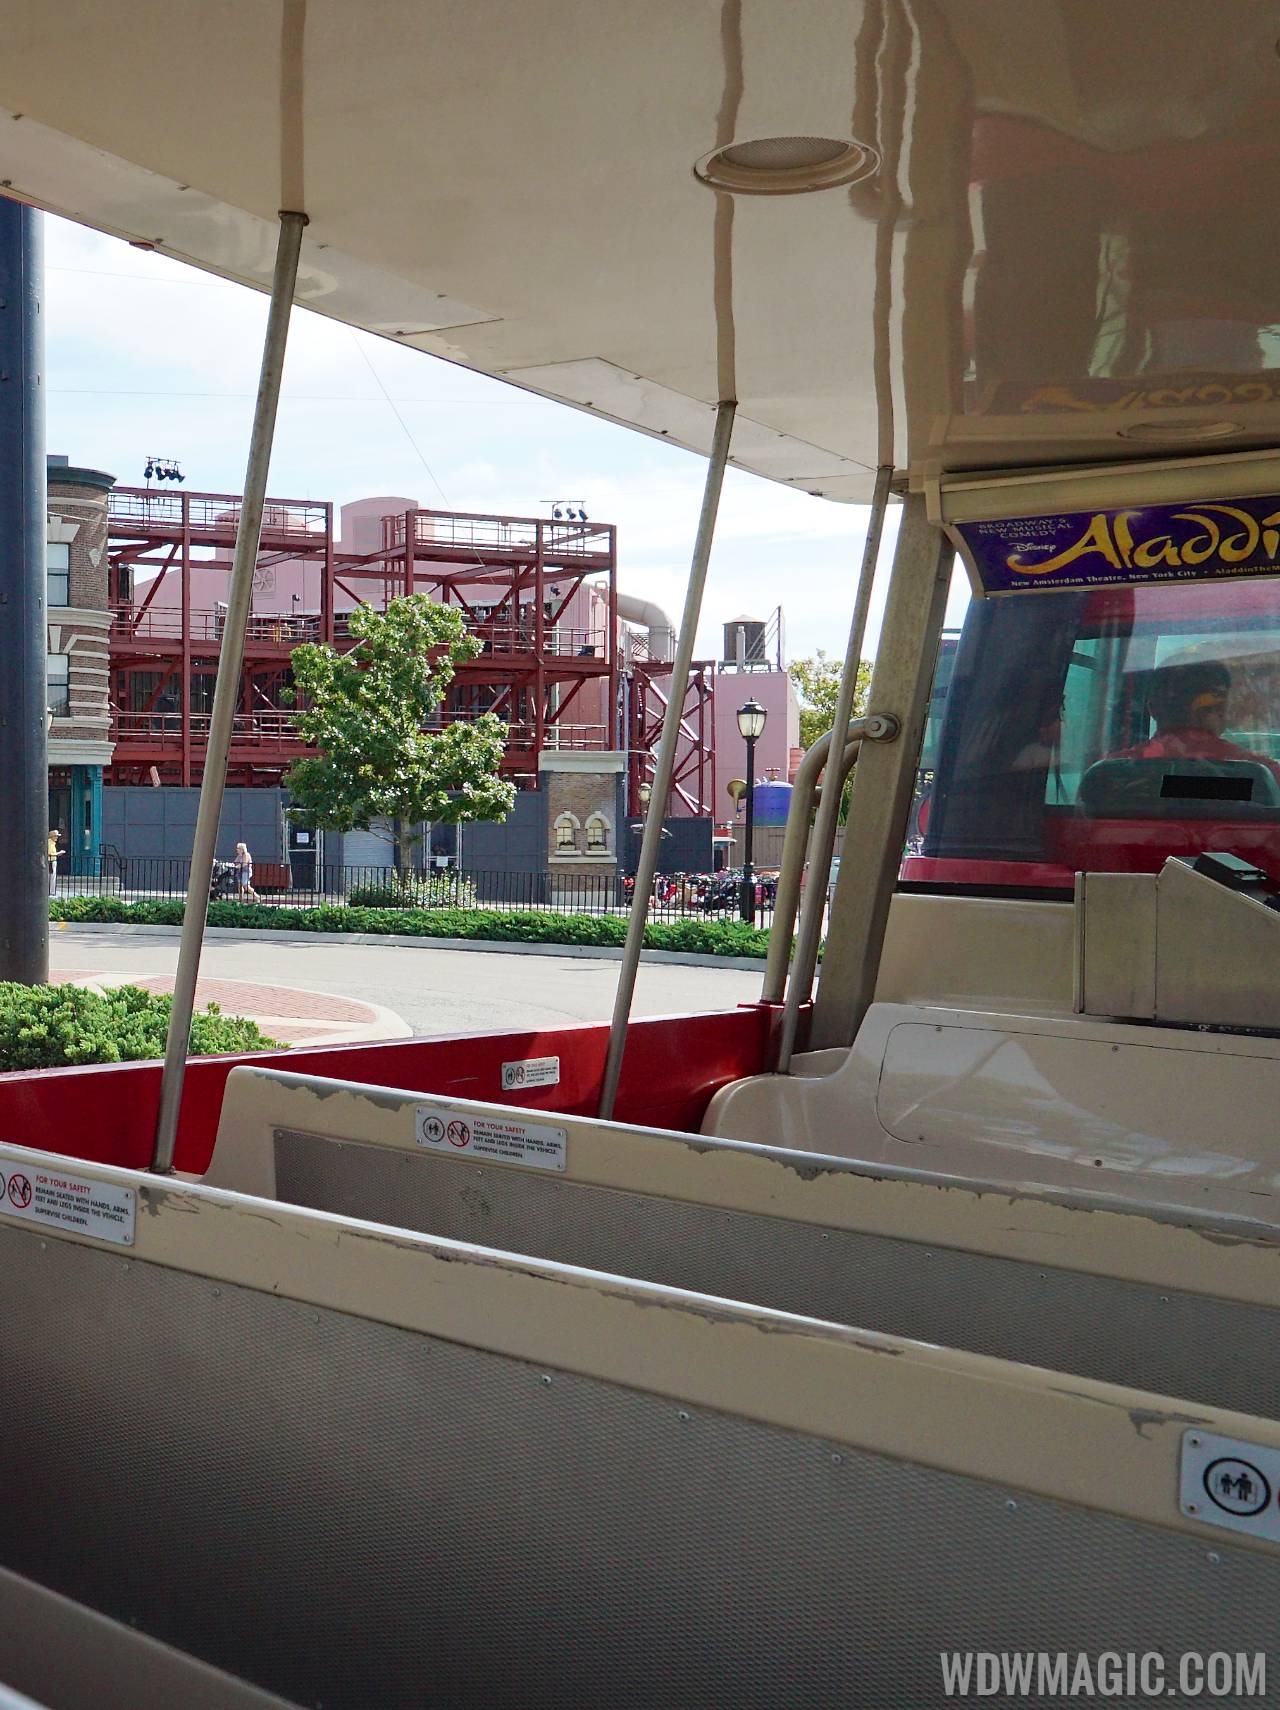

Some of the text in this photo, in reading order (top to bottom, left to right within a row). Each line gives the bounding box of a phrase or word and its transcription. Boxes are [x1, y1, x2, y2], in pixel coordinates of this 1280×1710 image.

[979, 523, 1074, 536] NEW MUSICAL
[1000, 529, 1057, 538] COMEDY
[1006, 505, 1280, 574] Aladdi
[1008, 542, 1057, 553] Disney
[1032, 577, 1084, 586] Amsterdam
[36, 1175, 91, 1194] FOR YOUR SAFETY
[35, 1186, 55, 1196] REMAIN
[56, 1192, 74, 1201] SEATED
[47, 1197, 58, 1205] AND
[73, 1204, 89, 1214] INSIDE
[35, 1207, 60, 1219] SUPERVISE
